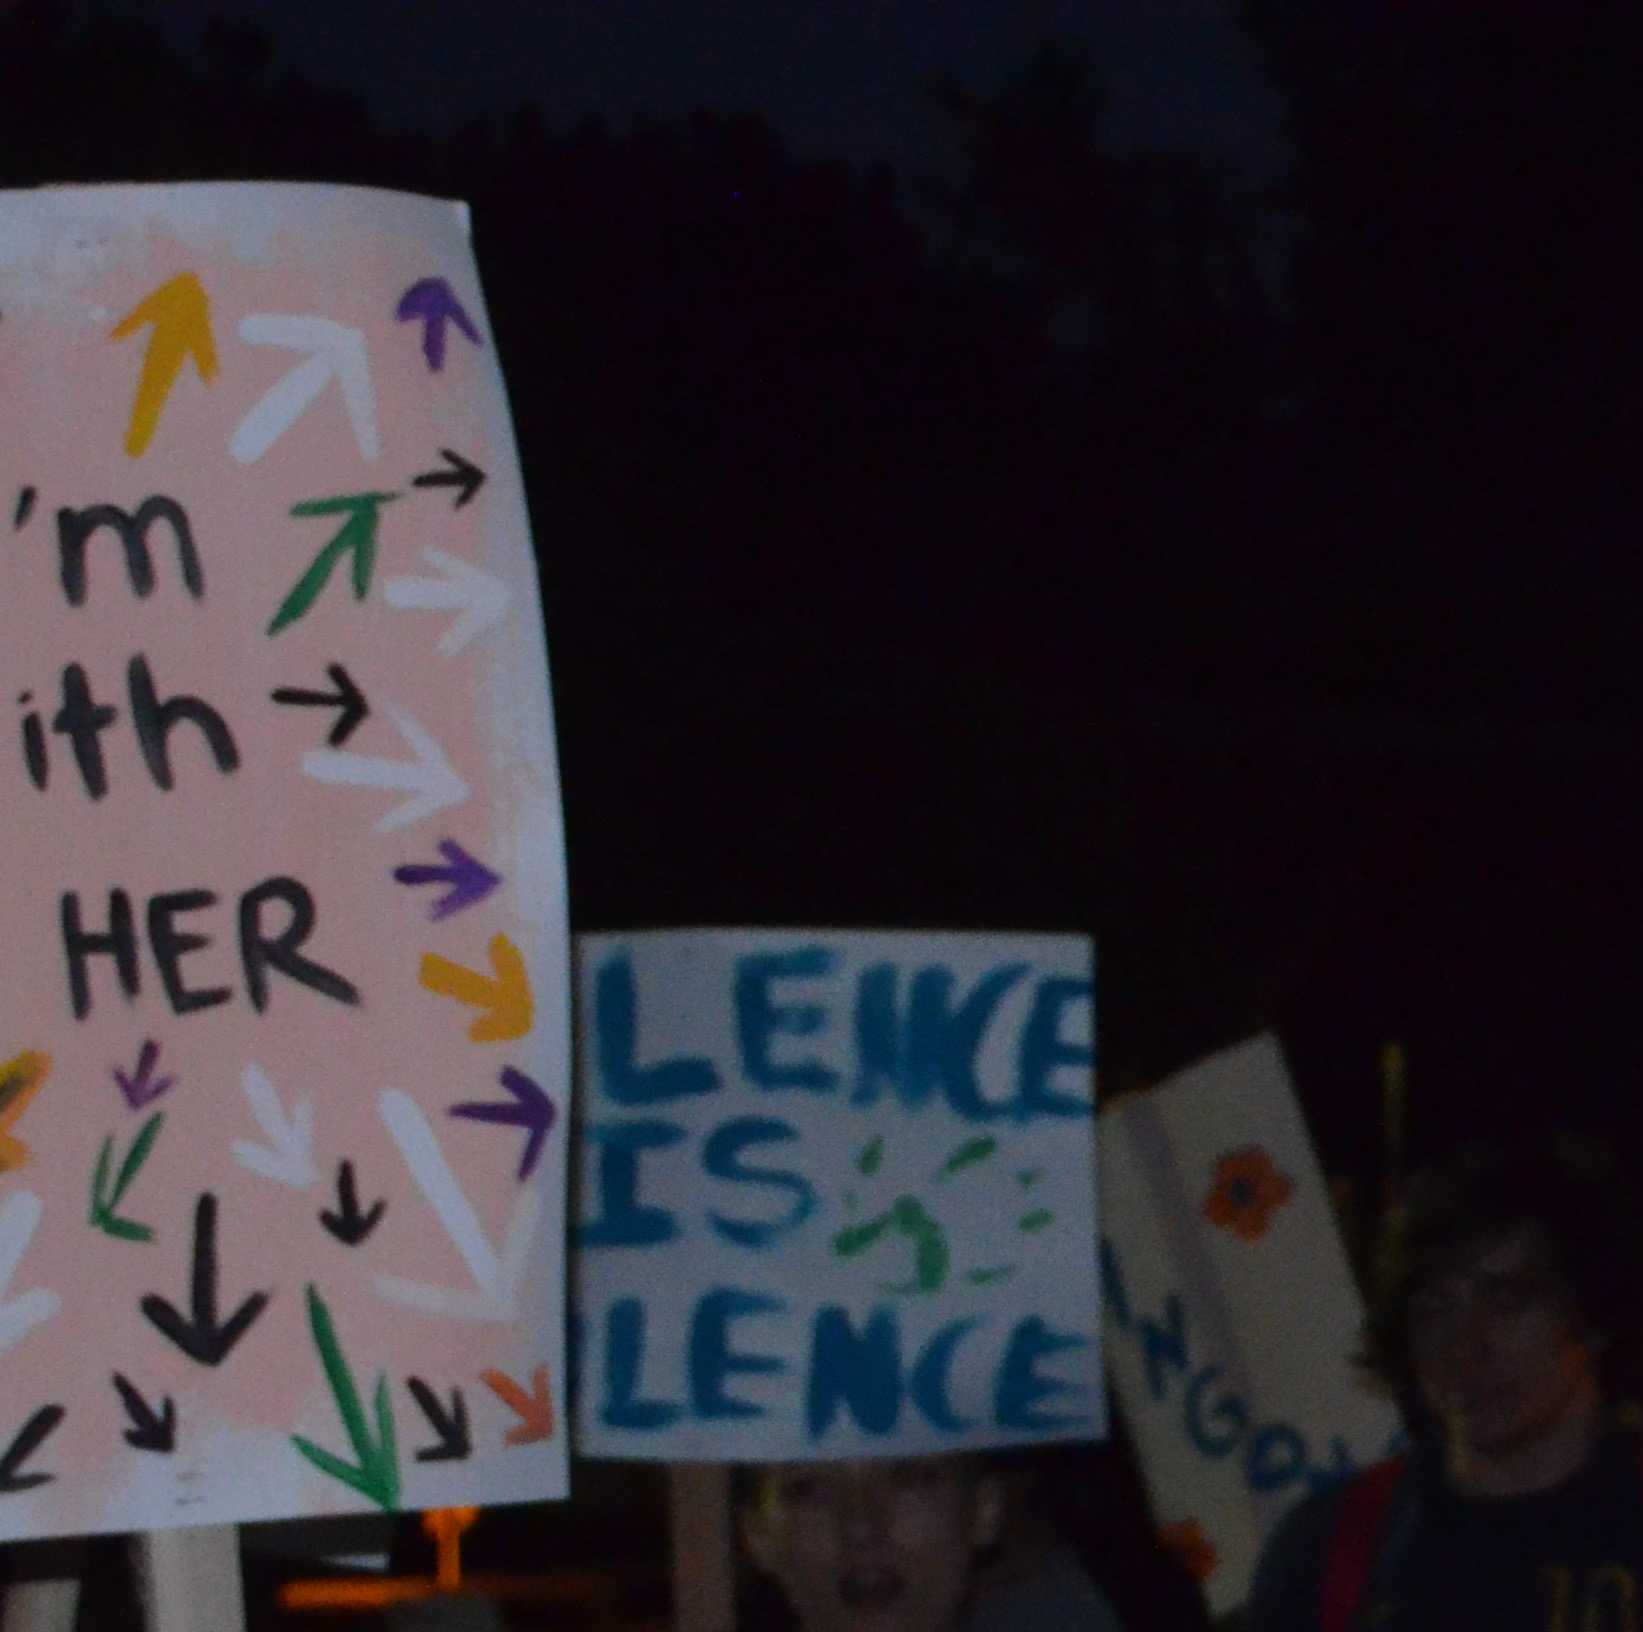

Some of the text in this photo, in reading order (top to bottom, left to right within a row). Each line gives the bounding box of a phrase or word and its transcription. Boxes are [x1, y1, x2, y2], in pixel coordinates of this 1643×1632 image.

[20, 652, 240, 801] ith
[60, 876, 362, 1021] HER
[576, 1115, 820, 1248] IS
